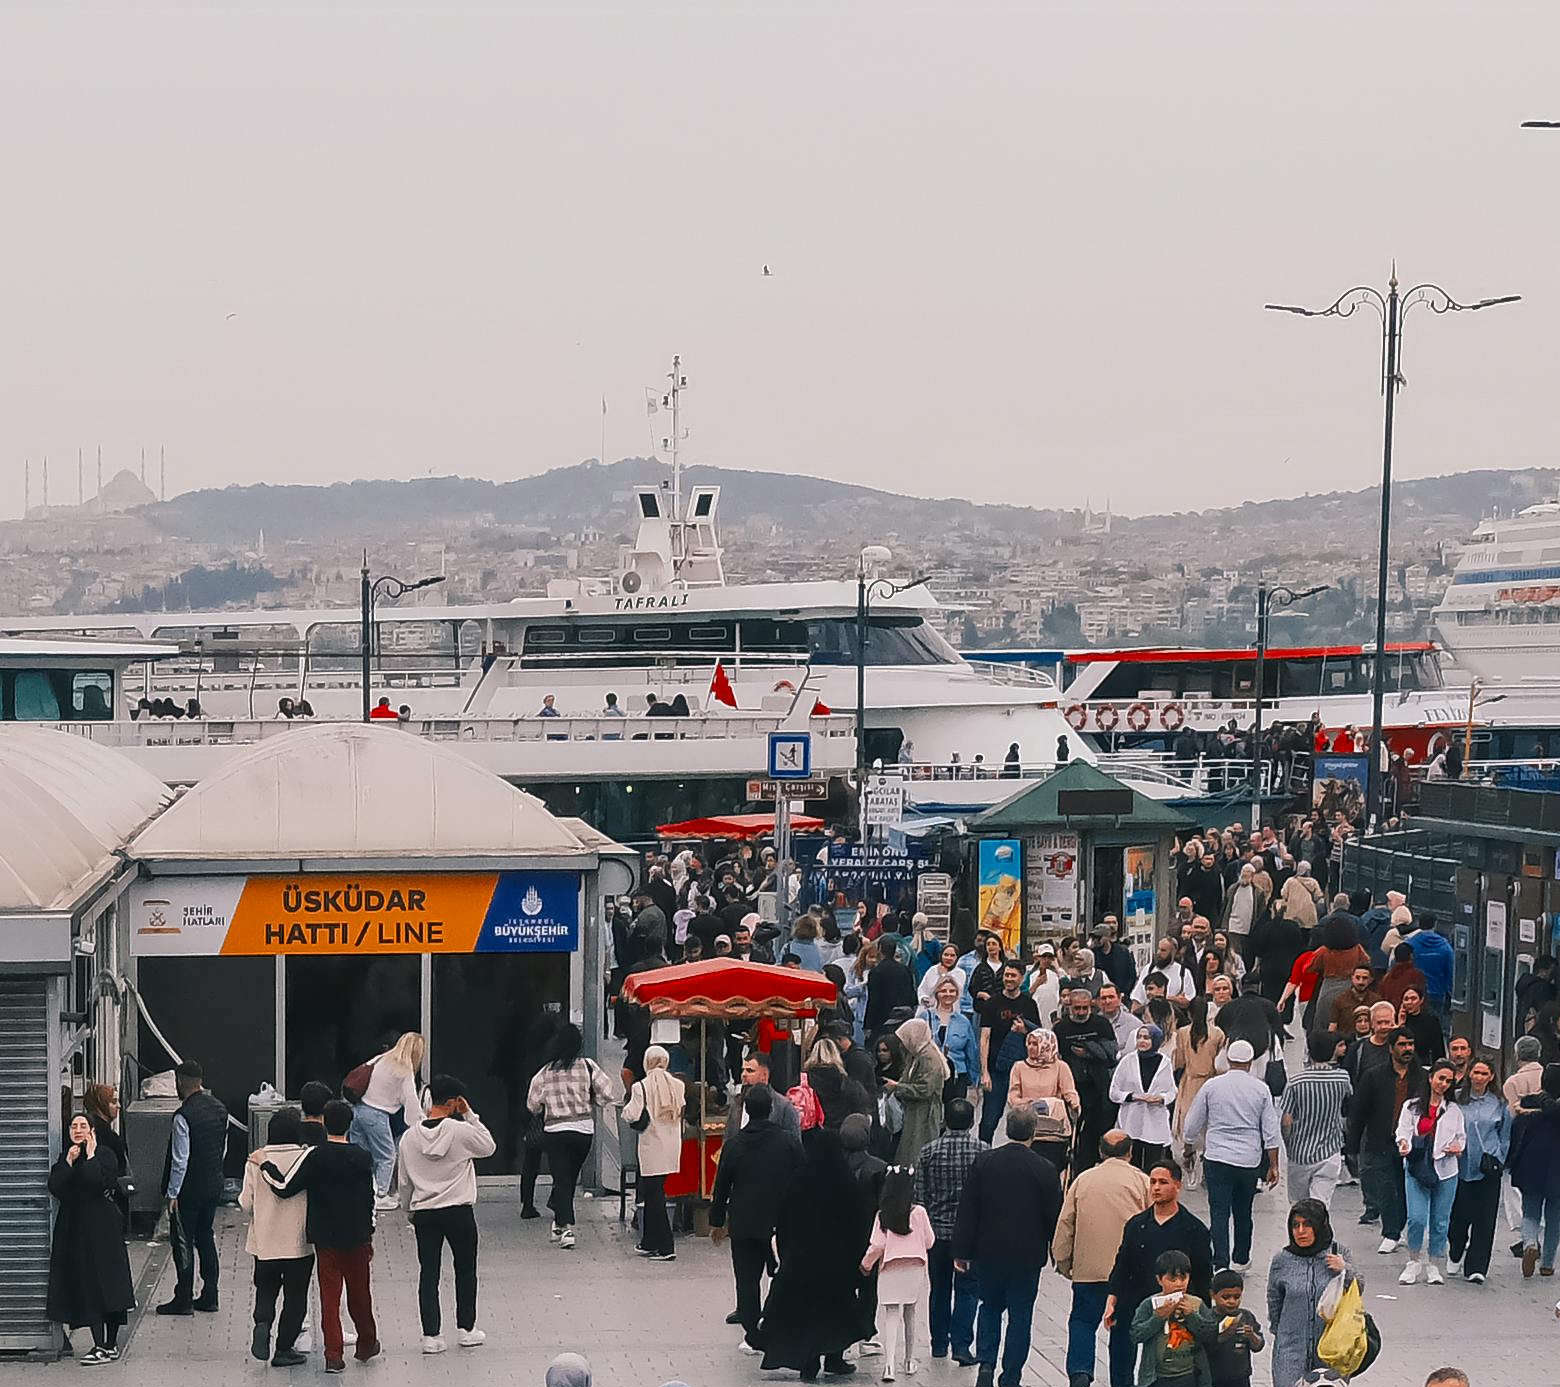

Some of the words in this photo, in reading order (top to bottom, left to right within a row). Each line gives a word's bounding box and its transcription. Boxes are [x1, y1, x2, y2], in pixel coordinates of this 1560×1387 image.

[615, 592, 688, 610] TAFRALI
[283, 884, 426, 912] ÜSKÜDAR
[266, 922, 348, 945] HATTI
[379, 921, 443, 944] LINE
[494, 923, 569, 940] BÜYÜKŞEHİR
